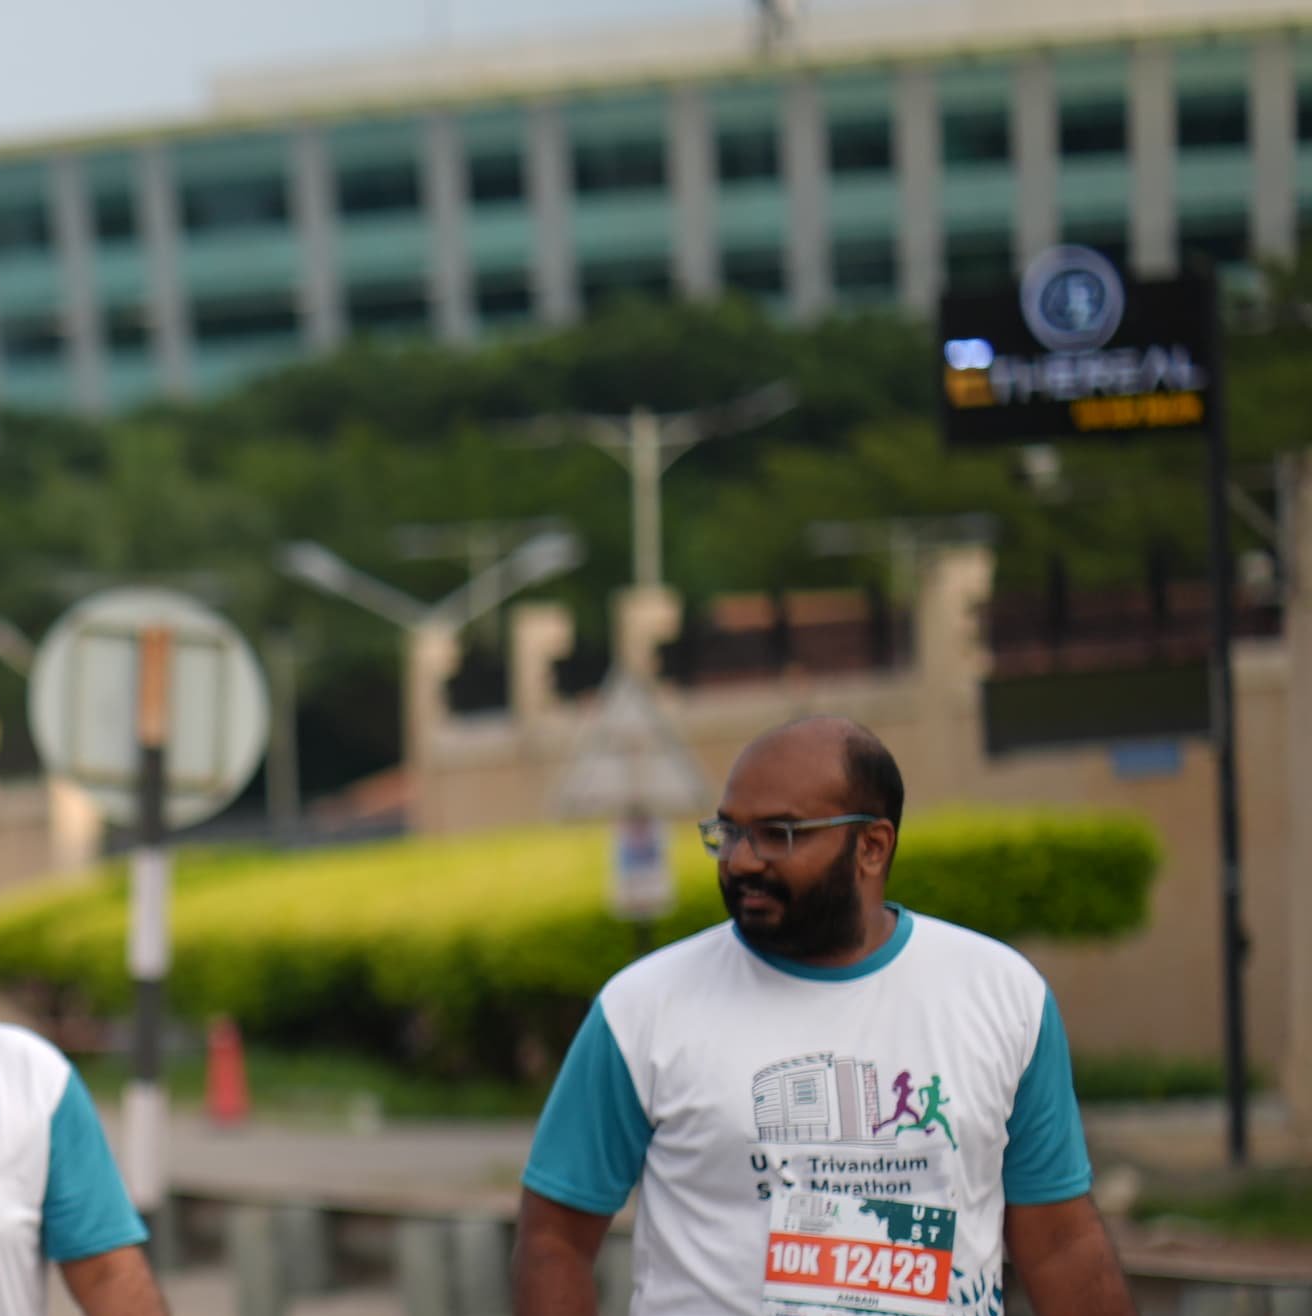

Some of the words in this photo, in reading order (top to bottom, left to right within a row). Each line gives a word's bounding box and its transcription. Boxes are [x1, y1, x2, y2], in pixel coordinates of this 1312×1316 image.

[808, 1155, 929, 1175] Trivandrum
[810, 1177, 912, 1196] Marathon
[770, 1241, 820, 1276] 10K
[831, 1245, 938, 1296] 12423
